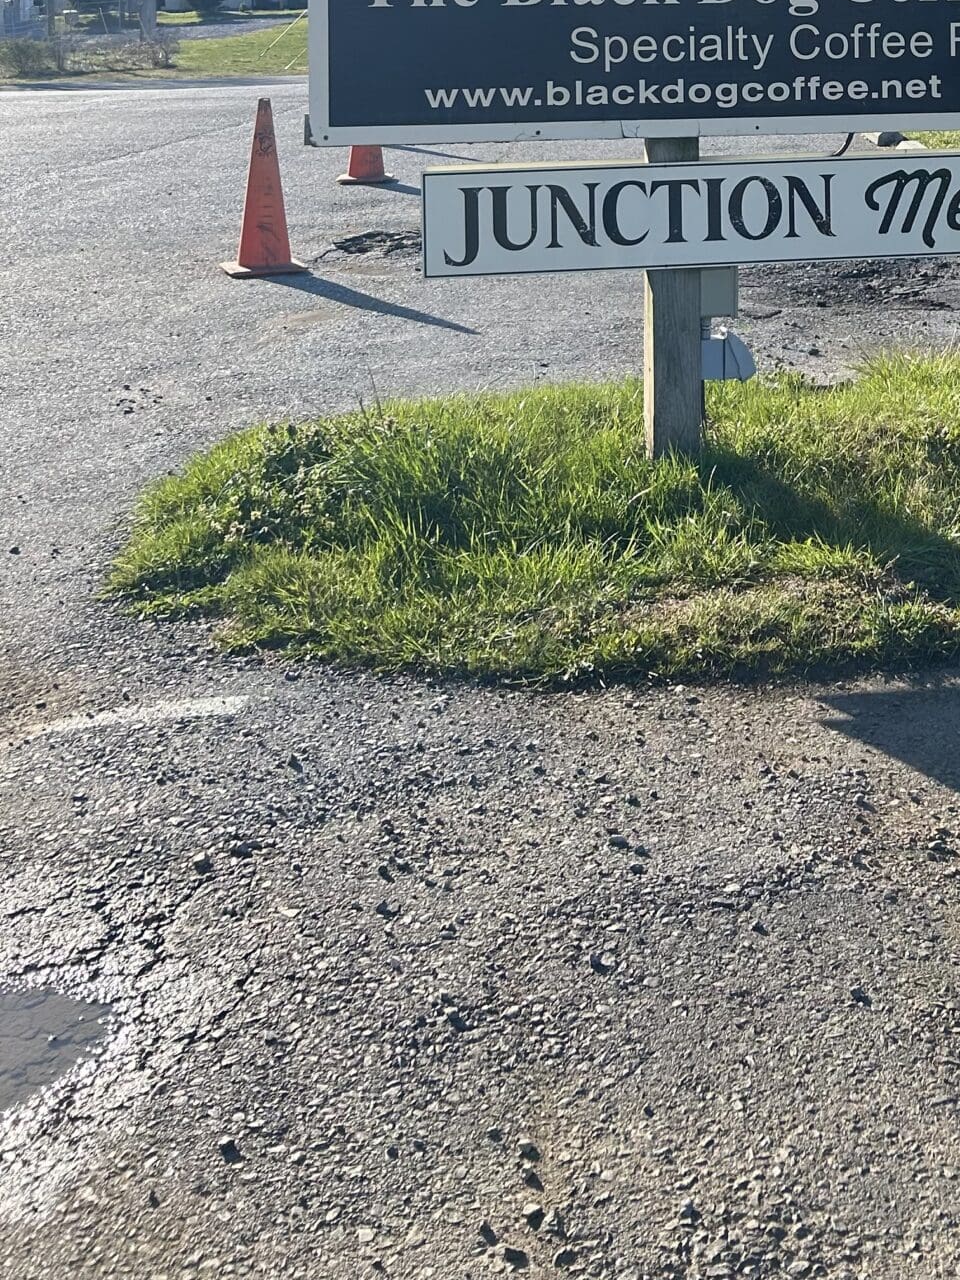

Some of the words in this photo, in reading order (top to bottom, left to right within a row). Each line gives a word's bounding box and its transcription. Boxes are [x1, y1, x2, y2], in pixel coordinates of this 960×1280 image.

[569, 25, 774, 73] Specialty
[788, 21, 932, 61] Coffee
[424, 74, 943, 109] www.blackdogcoffee.net
[443, 173, 838, 266] JUNCTION
